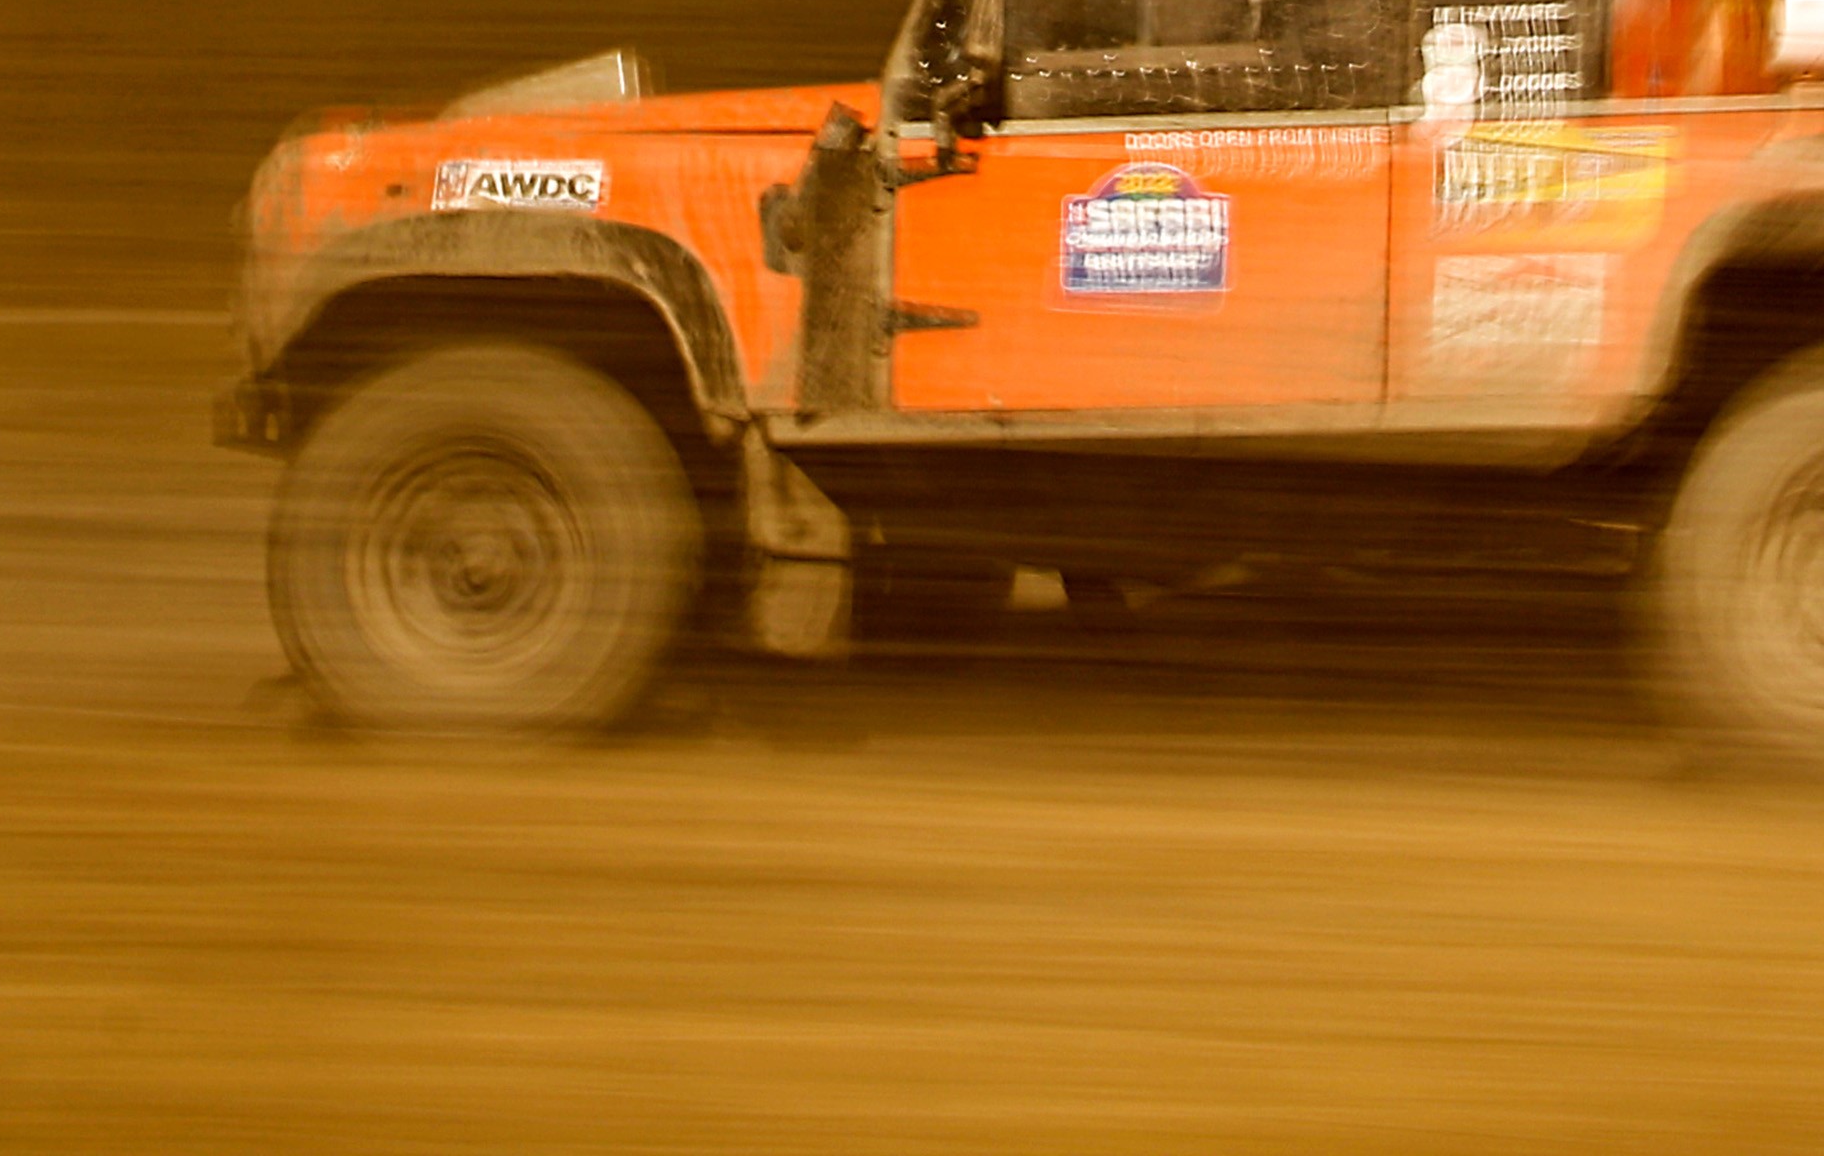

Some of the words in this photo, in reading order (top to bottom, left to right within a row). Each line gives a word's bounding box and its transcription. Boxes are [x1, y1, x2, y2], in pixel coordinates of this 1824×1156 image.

[1125, 132, 1194, 150] DOORS
[1199, 129, 1251, 147] OPEN
[1258, 128, 1312, 145] FROM
[470, 172, 596, 201] AWDC
